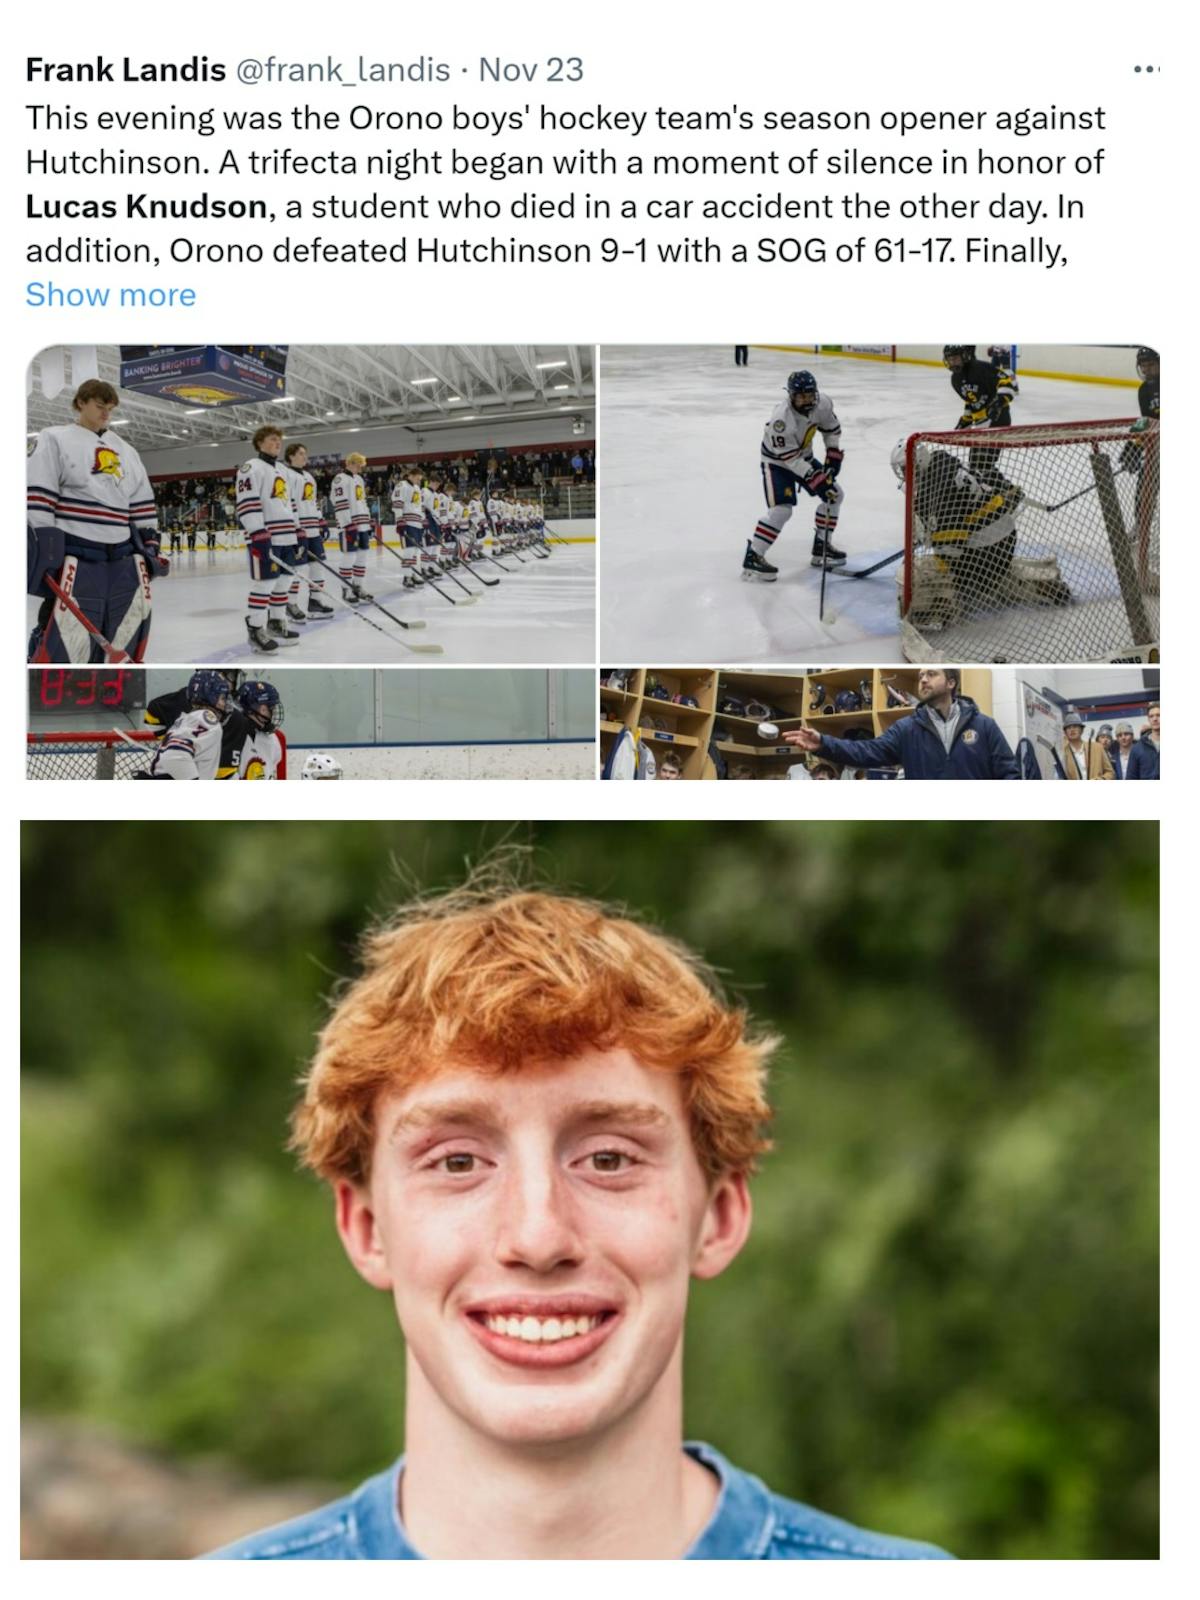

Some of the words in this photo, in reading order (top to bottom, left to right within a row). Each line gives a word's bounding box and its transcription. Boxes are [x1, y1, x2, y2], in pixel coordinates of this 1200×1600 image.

[26, 55, 115, 83] Frank
[123, 55, 227, 83] Landis
[236, 55, 451, 87] @frank_landis
[479, 56, 538, 82] Nov
[546, 56, 584, 82] 23
[24, 103, 89, 131] This
[97, 104, 216, 137] evening
[222, 111, 283, 131] was
[290, 103, 341, 131] the
[349, 104, 443, 131] Orono
[452, 103, 530, 137] boys'
[540, 103, 648, 137] hockey
[654, 103, 754, 131] team's
[763, 111, 871, 131] season
[880, 111, 988, 137] opener
[995, 104, 1107, 137] against
[27, 147, 210, 175] Hutchinson.
[218, 148, 241, 175] A
[247, 147, 357, 175] trifecta
[367, 147, 443, 181] night
[451, 147, 543, 181] began
[552, 147, 617, 175] with
[626, 155, 643, 175] a
[653, 150, 780, 175] moment
[787, 147, 819, 175] of
[826, 147, 933, 175] silence
[942, 148, 968, 175] in
[978, 147, 1067, 175] honor
[1074, 147, 1106, 175] of
[26, 193, 118, 219] Lucas
[126, 191, 276, 223] Knudson,
[285, 199, 303, 219] a
[311, 191, 430, 219] student
[437, 191, 502, 219] who
[510, 191, 575, 219] died
[584, 192, 611, 219] in
[620, 199, 637, 219] a
[646, 199, 694, 219] car
[702, 191, 834, 219] accident
[840, 191, 891, 219] the
[899, 191, 981, 219] other
[988, 191, 1048, 225] day.
[1058, 193, 1084, 219] In
[26, 236, 160, 268] addition,
[169, 237, 264, 263] Orono
[272, 236, 407, 263] defeated
[417, 236, 591, 263] Hutchinson
[600, 237, 646, 263] 9-1
[656, 236, 721, 263] with
[731, 243, 748, 263] a
[756, 237, 827, 263] SOG
[835, 236, 867, 263] of
[874, 237, 956, 263] 61-17.
[966, 236, 1068, 270] Finally,
[25, 280, 111, 307] Show
[120, 287, 197, 307] more
[123, 363, 160, 378] BANKING
[160, 356, 201, 371] BRIGHTER
[771, 435, 785, 448] 19
[139, 560, 152, 600] CCM
[192, 724, 209, 738] 7
